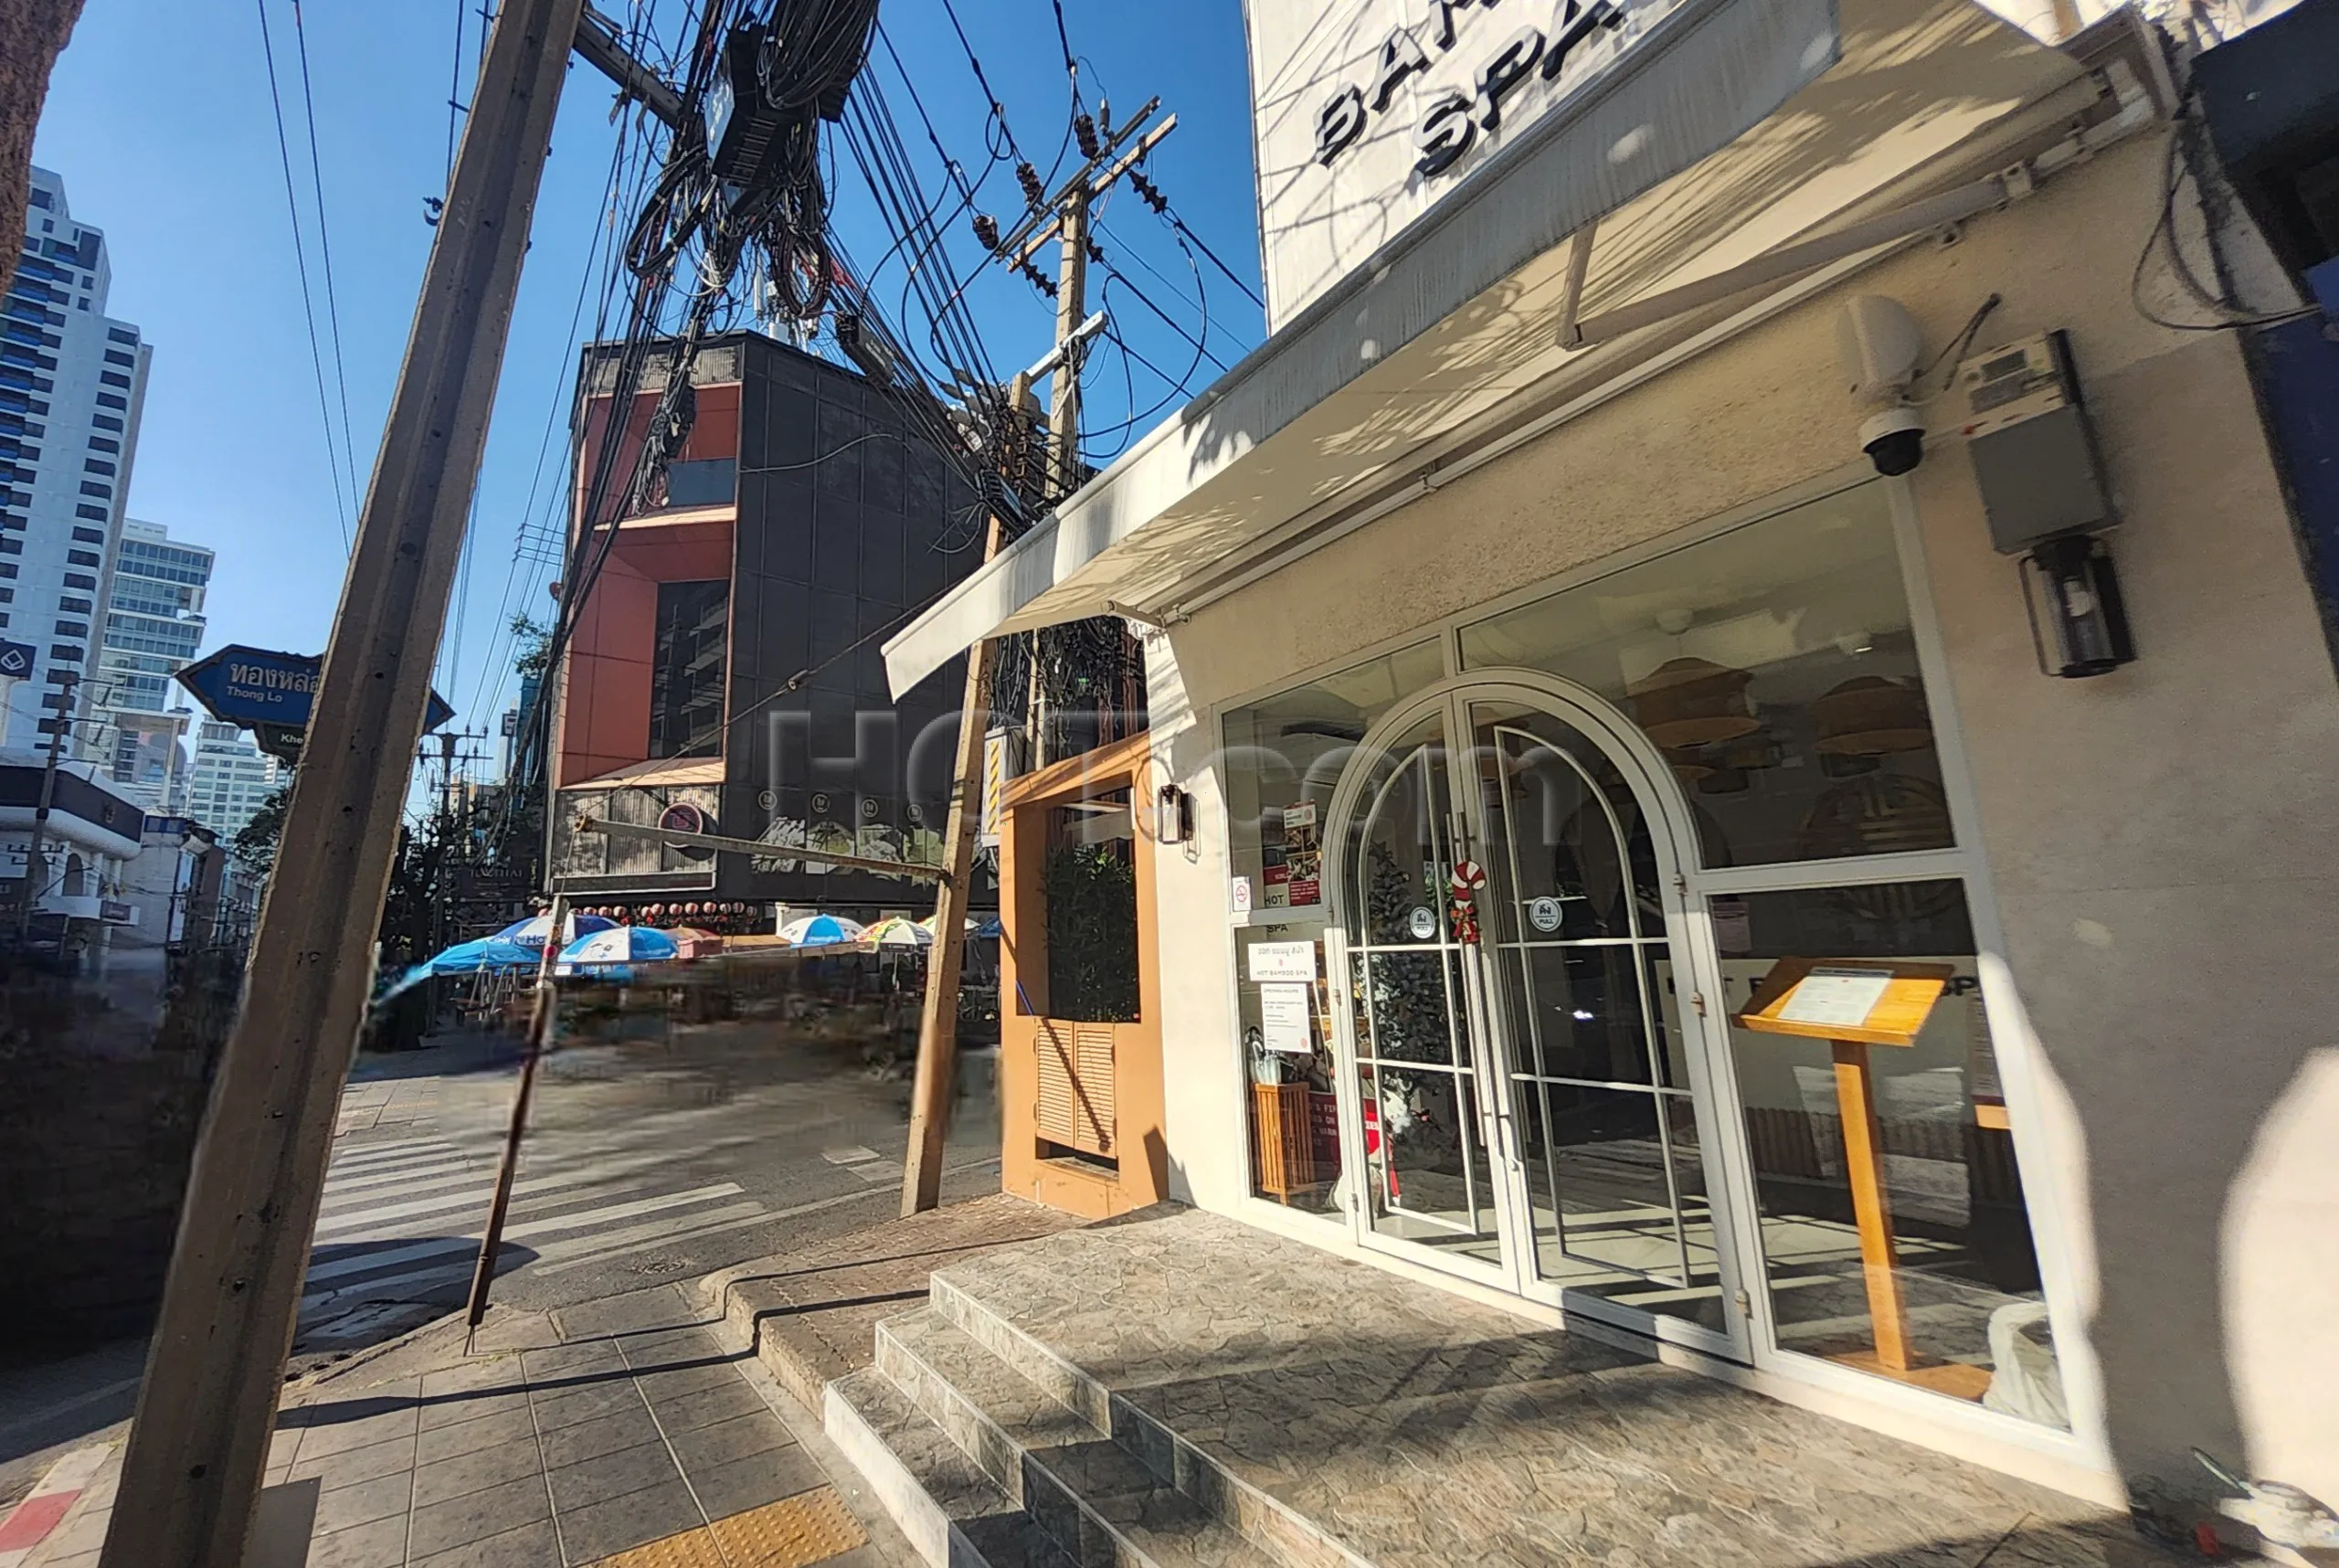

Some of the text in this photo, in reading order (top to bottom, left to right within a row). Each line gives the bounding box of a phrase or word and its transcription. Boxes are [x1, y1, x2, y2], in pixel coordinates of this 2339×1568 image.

[1413, 0, 1625, 177] SPA
[227, 686, 283, 703] Thong Lo
[1264, 895, 1285, 906] HOT
[1267, 925, 1288, 933] SPA
